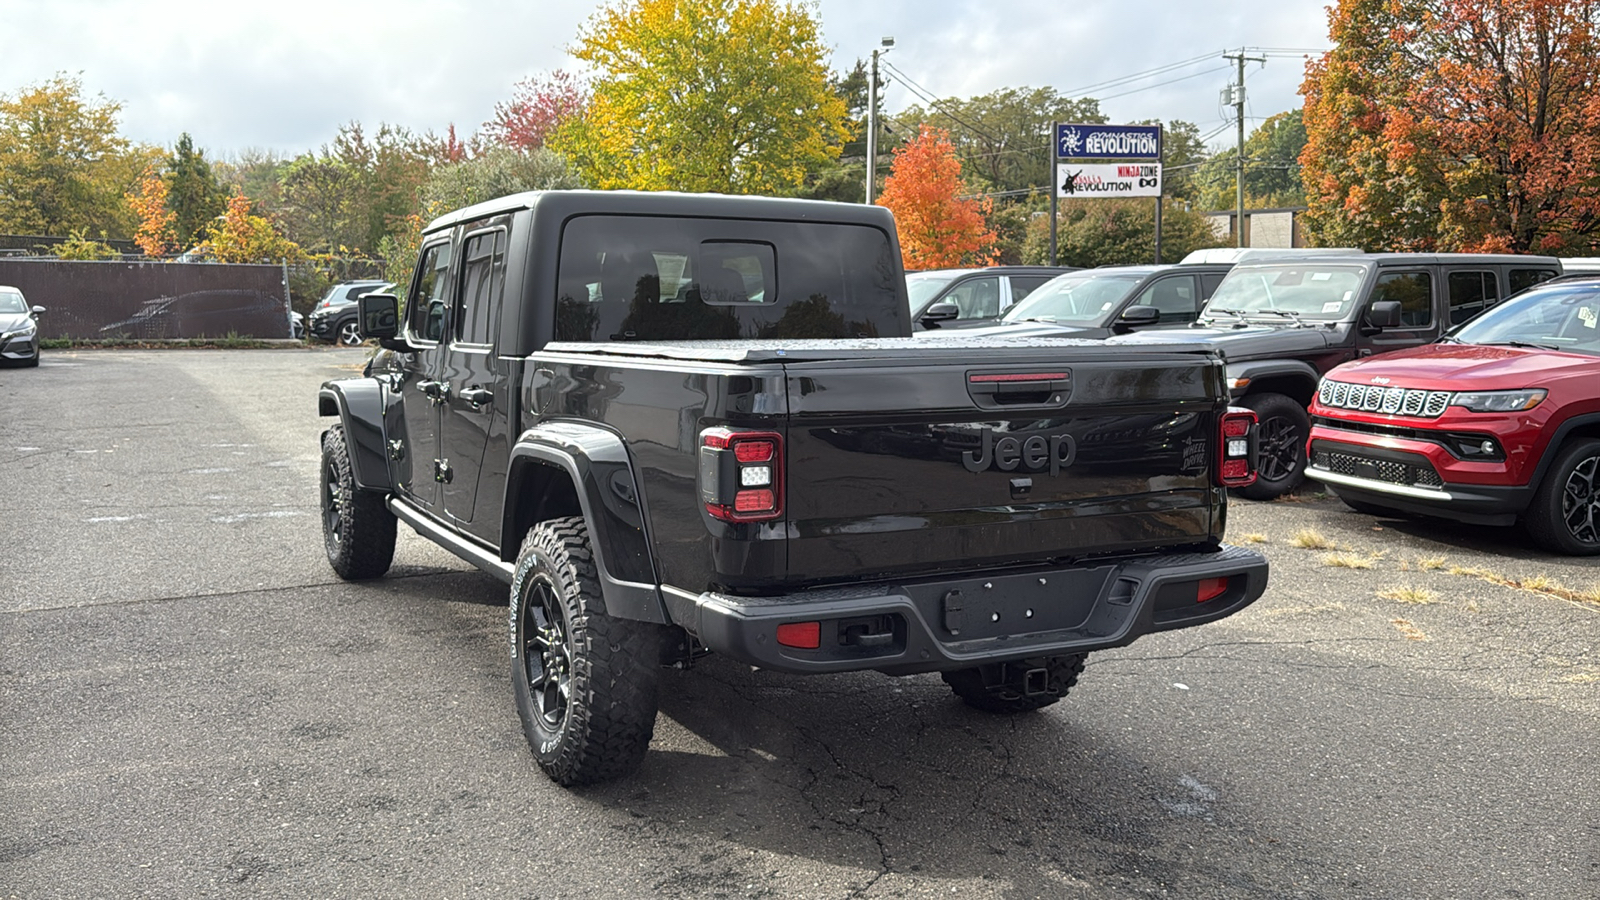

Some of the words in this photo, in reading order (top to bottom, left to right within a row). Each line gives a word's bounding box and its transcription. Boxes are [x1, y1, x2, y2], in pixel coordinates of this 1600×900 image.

[1089, 132, 1153, 140] GYMNASTICS
[1086, 138, 1156, 153] REVOLUTION
[1117, 166, 1158, 177] NINJAZONE
[1073, 182, 1132, 191] REVOLUTION
[1371, 375, 1390, 385] Jeep
[1186, 435, 1192, 446] 4
[962, 427, 1077, 478] Jeep
[1182, 442, 1206, 459] WHEEL
[1181, 452, 1207, 471] DRIVE
